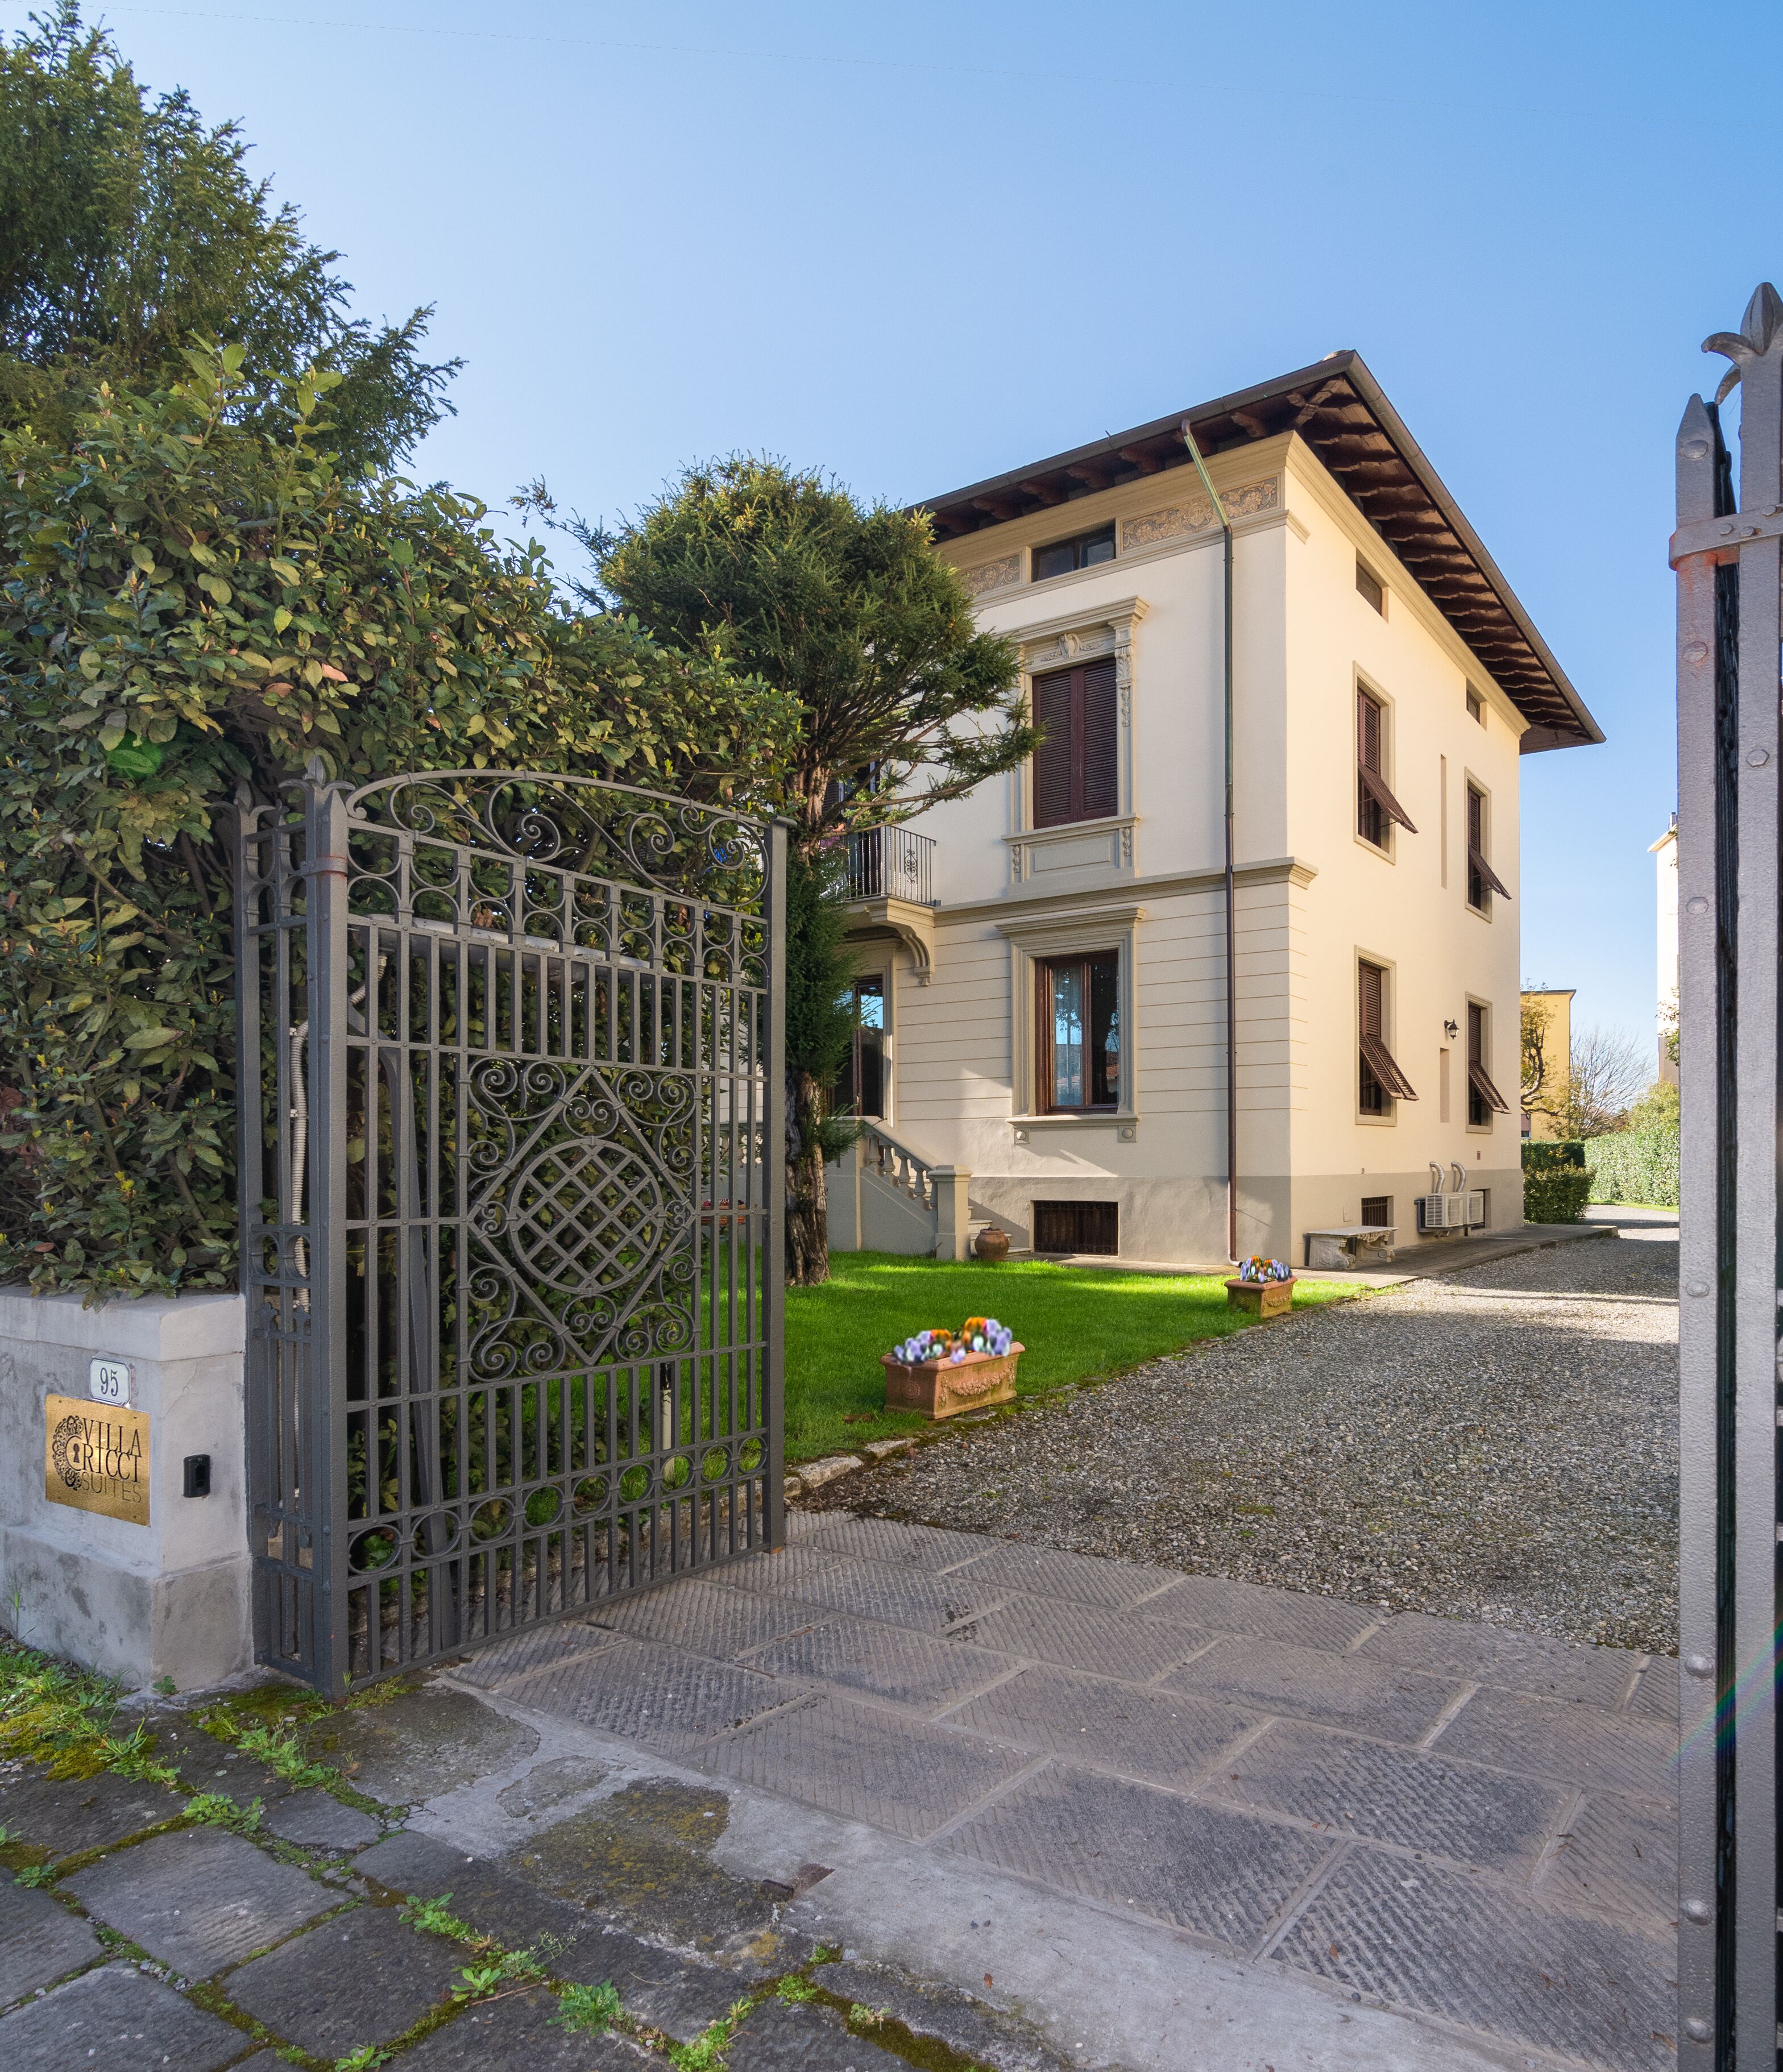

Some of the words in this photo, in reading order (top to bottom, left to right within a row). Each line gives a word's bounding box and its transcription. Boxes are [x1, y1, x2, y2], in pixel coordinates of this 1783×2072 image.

[100, 1367, 118, 1397] 95
[82, 1418, 142, 1457] VILLA
[82, 1443, 140, 1483] RICCI
[81, 1471, 142, 1503] SUITES
